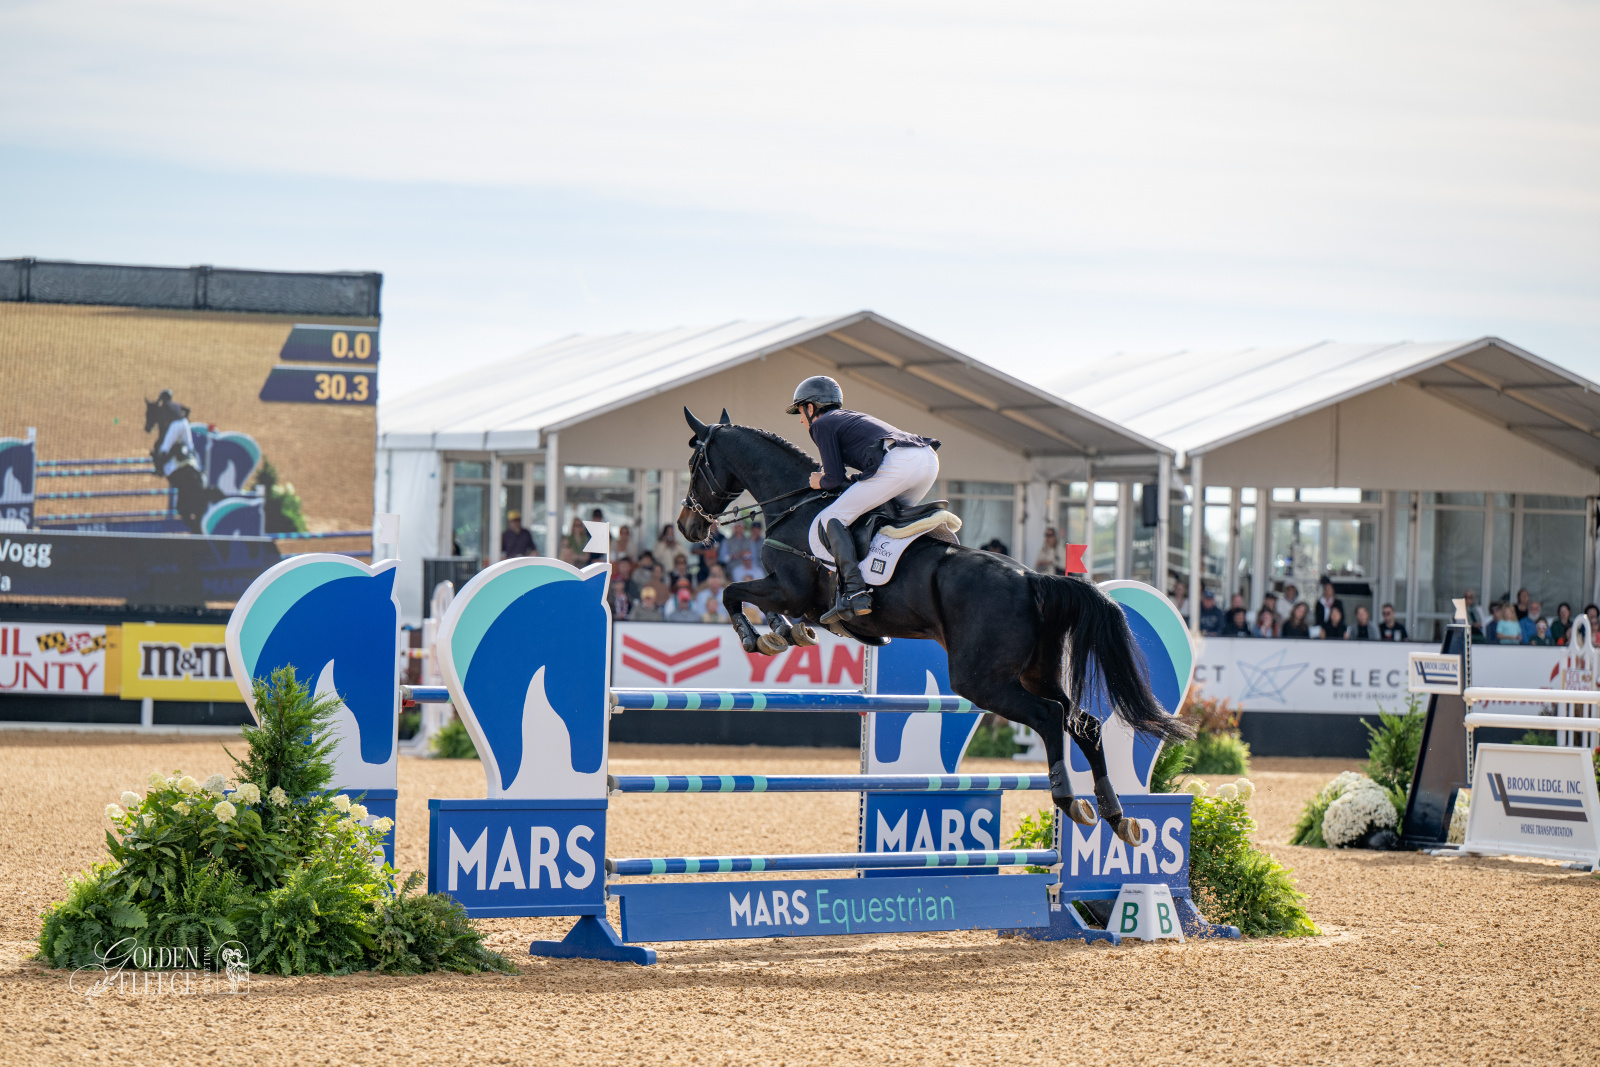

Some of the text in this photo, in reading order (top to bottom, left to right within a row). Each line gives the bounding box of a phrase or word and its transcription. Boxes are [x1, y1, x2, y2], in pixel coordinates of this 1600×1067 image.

[331, 331, 371, 359] 0.0
[314, 373, 369, 401] 30.3
[0, 538, 53, 568] Vogg
[740, 642, 864, 685] YAN
[1314, 667, 1409, 688] SELEC
[1507, 776, 1583, 795] BROOK LEDGE, INC.
[876, 808, 994, 852] MARS
[1520, 823, 1573, 838] HORSE TRANSPORTATION
[448, 824, 596, 891] MARS
[1071, 817, 1184, 876] MARS
[729, 887, 955, 933] MARS Equestrian
[1120, 902, 1139, 934] B
[1157, 902, 1173, 934] B
